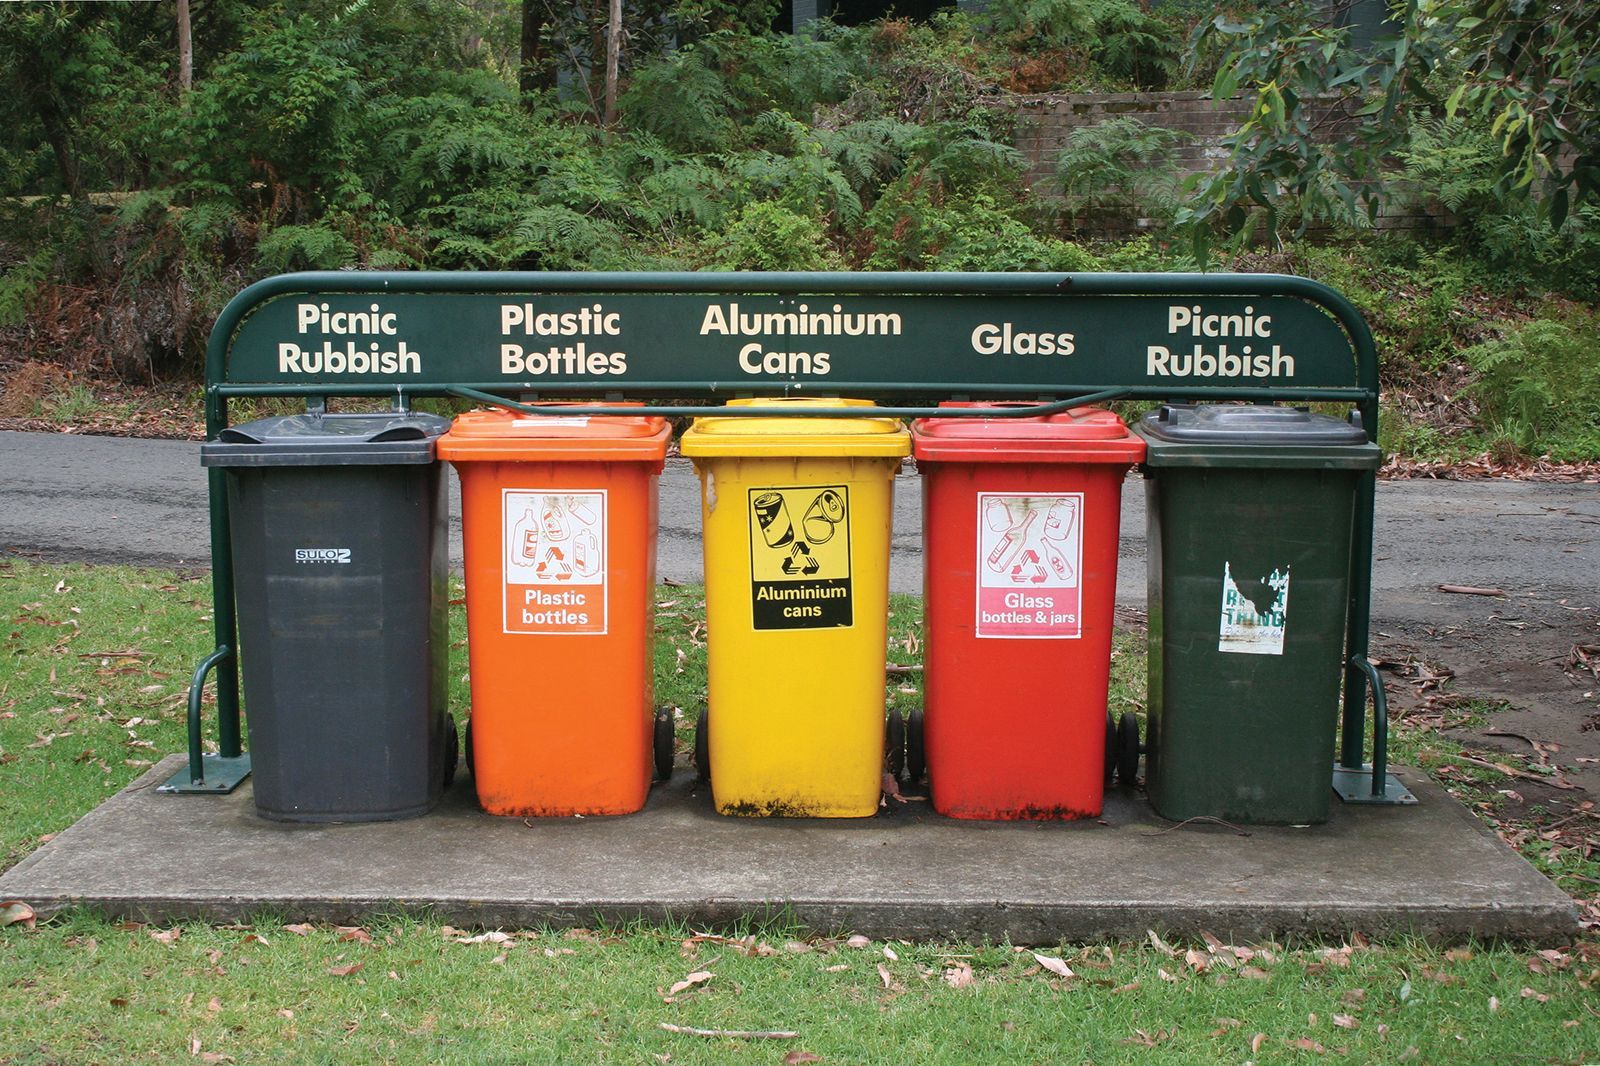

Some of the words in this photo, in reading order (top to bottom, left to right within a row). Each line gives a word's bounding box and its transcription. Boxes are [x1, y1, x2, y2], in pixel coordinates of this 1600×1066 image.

[299, 303, 396, 335] Picnic
[502, 304, 619, 335] Plastic
[700, 305, 901, 335] Aluminium
[1169, 306, 1270, 337] Picnic
[972, 323, 1074, 355] Glass
[279, 342, 421, 373] Rubbish
[502, 343, 626, 374] Bottles
[739, 343, 830, 374] Cans
[1147, 345, 1294, 377] Rubbish
[297, 550, 336, 559] SULO
[526, 590, 585, 605] Plastic
[757, 585, 846, 600] Aluminium
[1005, 593, 1053, 608] Glass
[523, 609, 588, 624] bottles
[784, 606, 821, 617] cans
[983, 611, 1031, 623] bottles
[1035, 611, 1046, 623] &
[1050, 612, 1075, 625] jars
